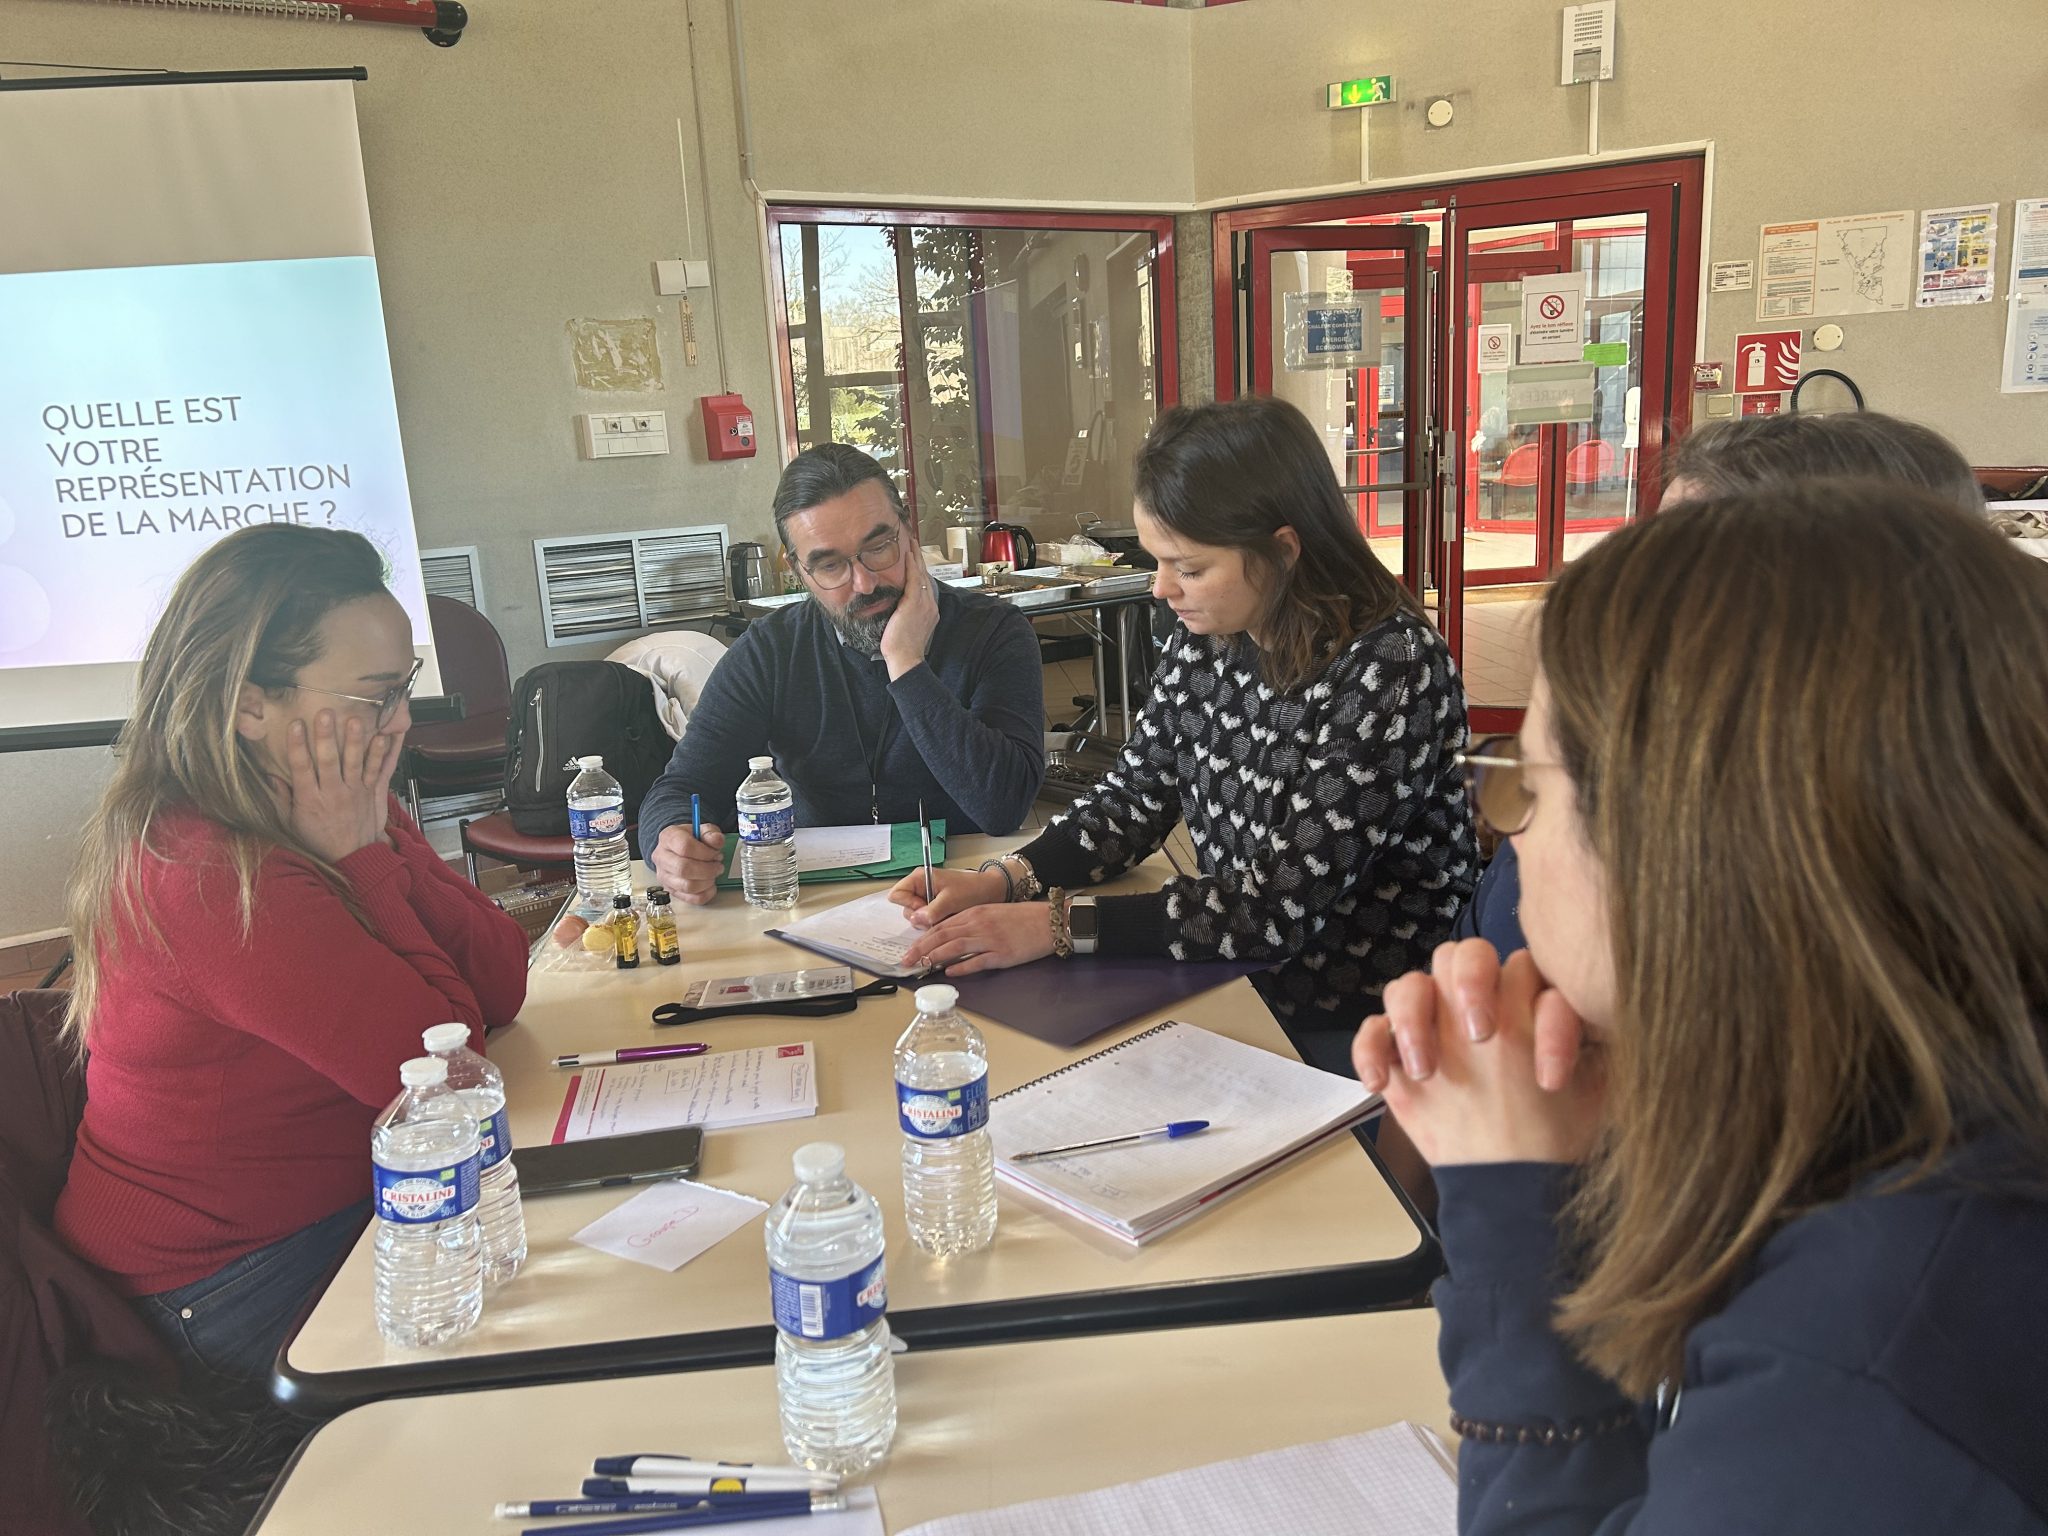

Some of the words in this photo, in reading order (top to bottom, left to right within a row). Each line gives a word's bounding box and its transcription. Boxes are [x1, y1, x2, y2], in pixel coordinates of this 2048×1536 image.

[43, 400, 174, 435] QUELLE
[184, 396, 241, 423] EST
[46, 438, 162, 467] VOTRE
[55, 464, 351, 503] REPRÉSENTATION
[61, 512, 107, 538] DE
[117, 509, 160, 535] LA
[168, 501, 310, 532] MARCHE
[320, 500, 337, 525] ?
[384, 1187, 454, 1203] CRISTALINE
